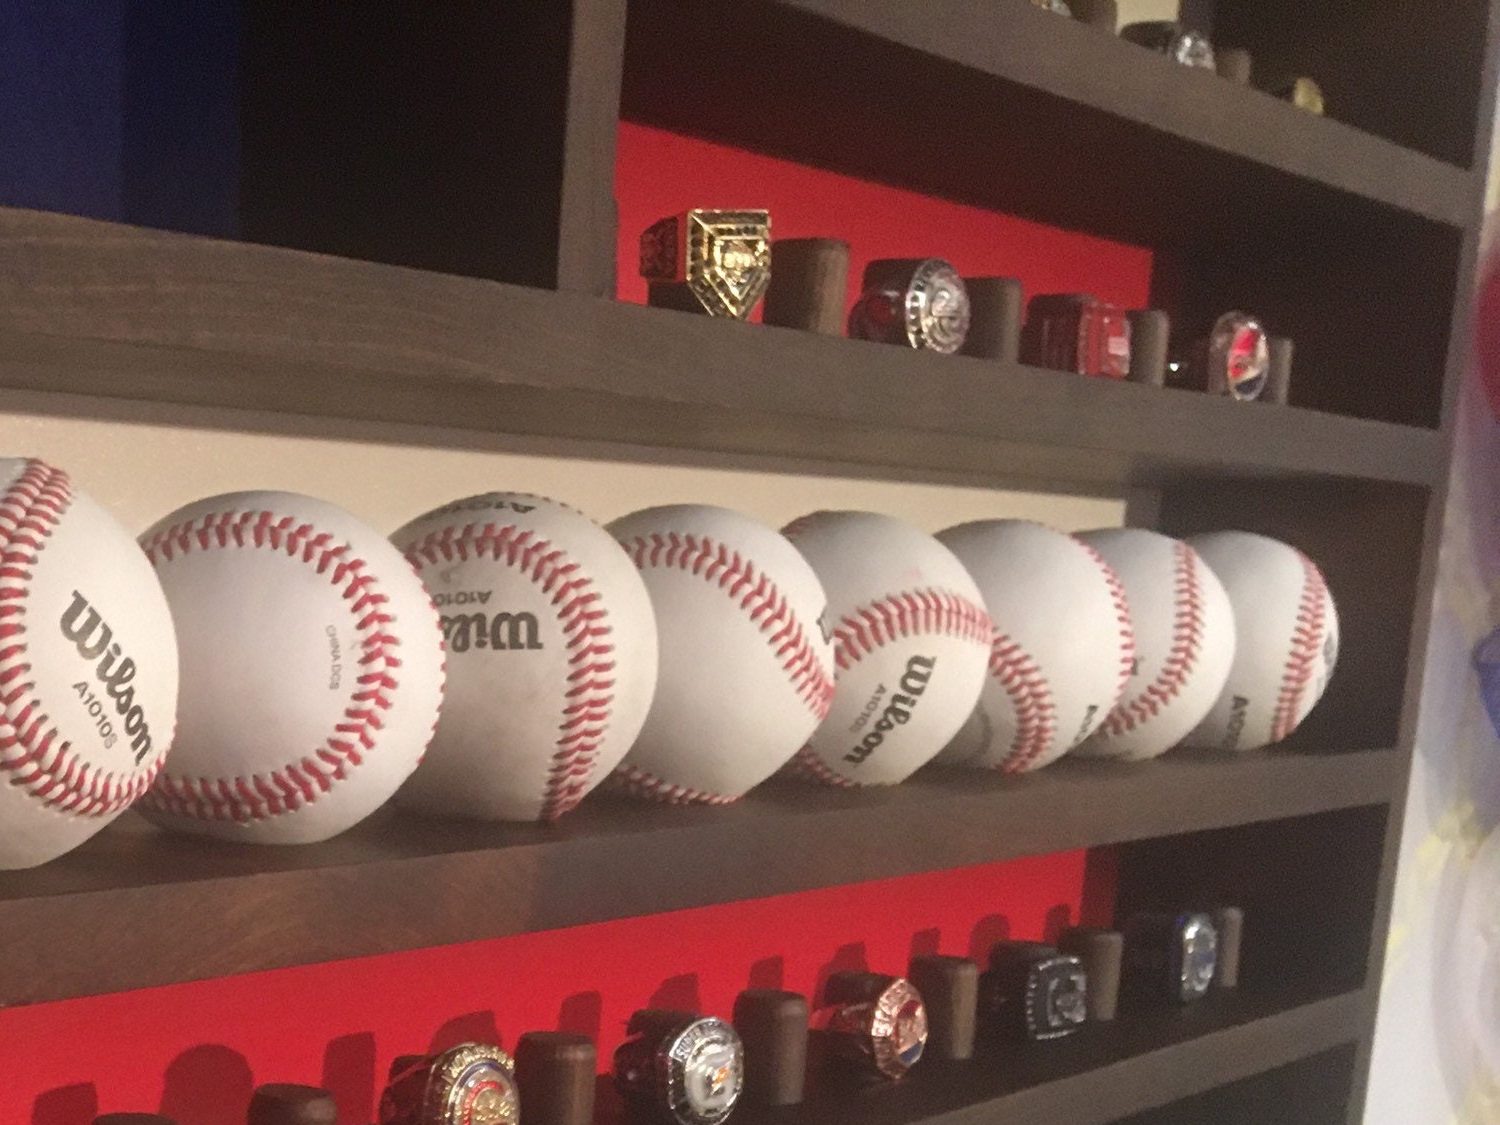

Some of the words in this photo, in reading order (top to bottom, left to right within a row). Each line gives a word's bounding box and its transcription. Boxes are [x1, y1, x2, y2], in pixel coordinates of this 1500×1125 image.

[432, 590, 492, 607] A1010
[440, 611, 543, 652] Wils
[60, 589, 152, 767] Wilson
[72, 681, 118, 749] A1010S
[842, 654, 937, 763] Wilson
[850, 684, 886, 733] A1010
